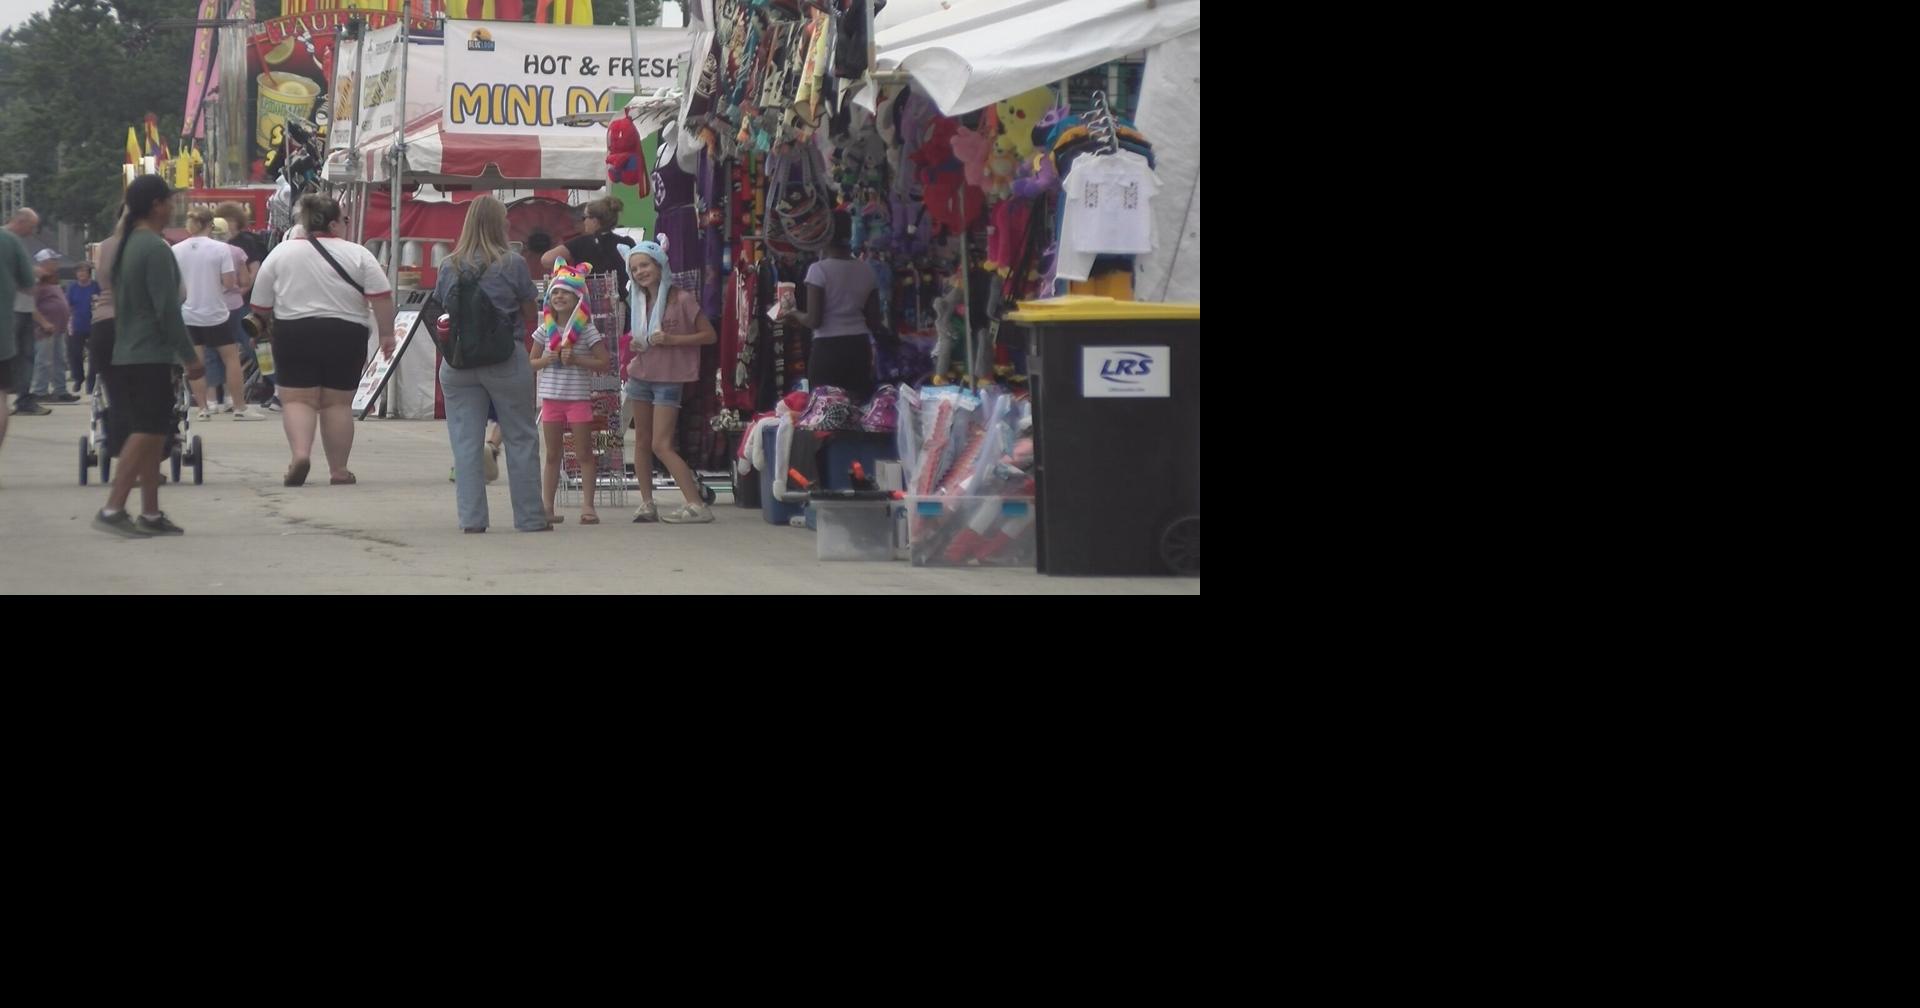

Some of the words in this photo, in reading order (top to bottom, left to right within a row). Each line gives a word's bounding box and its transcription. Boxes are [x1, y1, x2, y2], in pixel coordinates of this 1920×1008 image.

[524, 54, 571, 75] HOT
[579, 56, 600, 76] &
[451, 82, 554, 127] MINI
[1100, 359, 1154, 376] LRS
